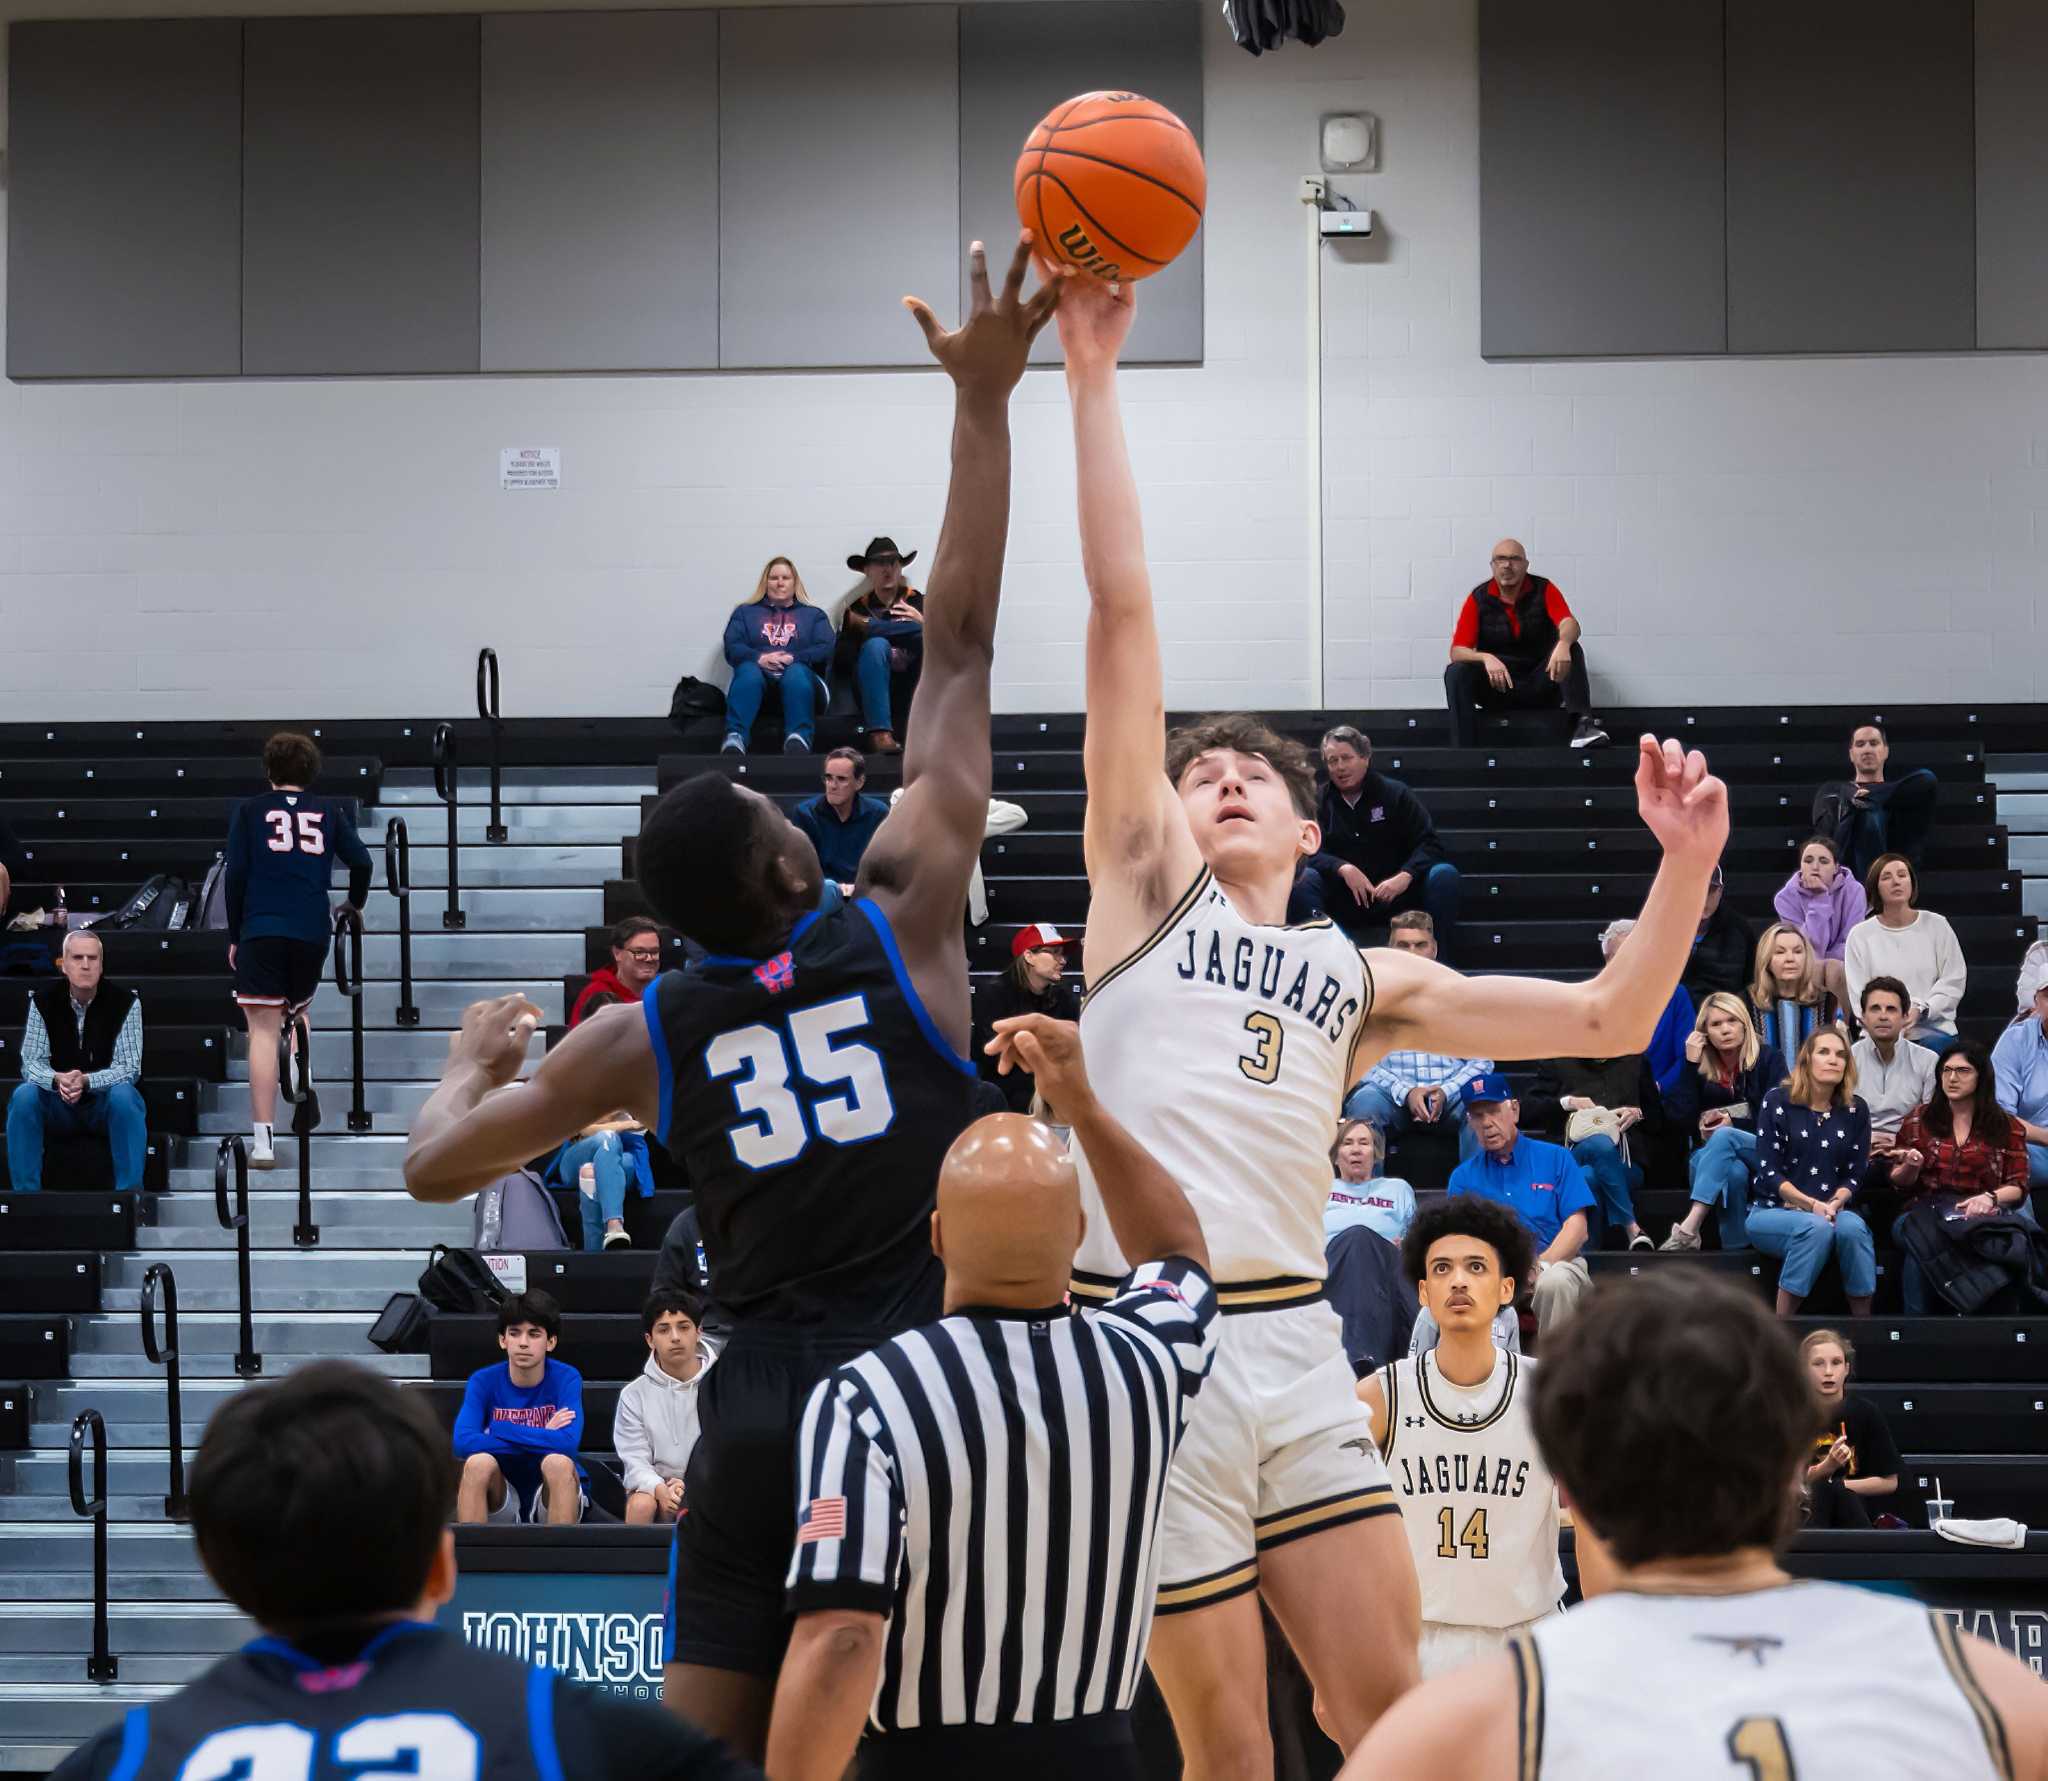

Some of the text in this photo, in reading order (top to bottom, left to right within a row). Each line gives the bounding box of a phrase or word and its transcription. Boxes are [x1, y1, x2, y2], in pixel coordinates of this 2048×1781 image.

[265, 809, 325, 855] 35
[1177, 929, 1358, 1043] JAGUARS
[1238, 1010, 1285, 1085] 3
[704, 993, 896, 1172] 35
[1400, 1454, 1530, 1498] JAGUARS
[1437, 1507, 1489, 1559] 14
